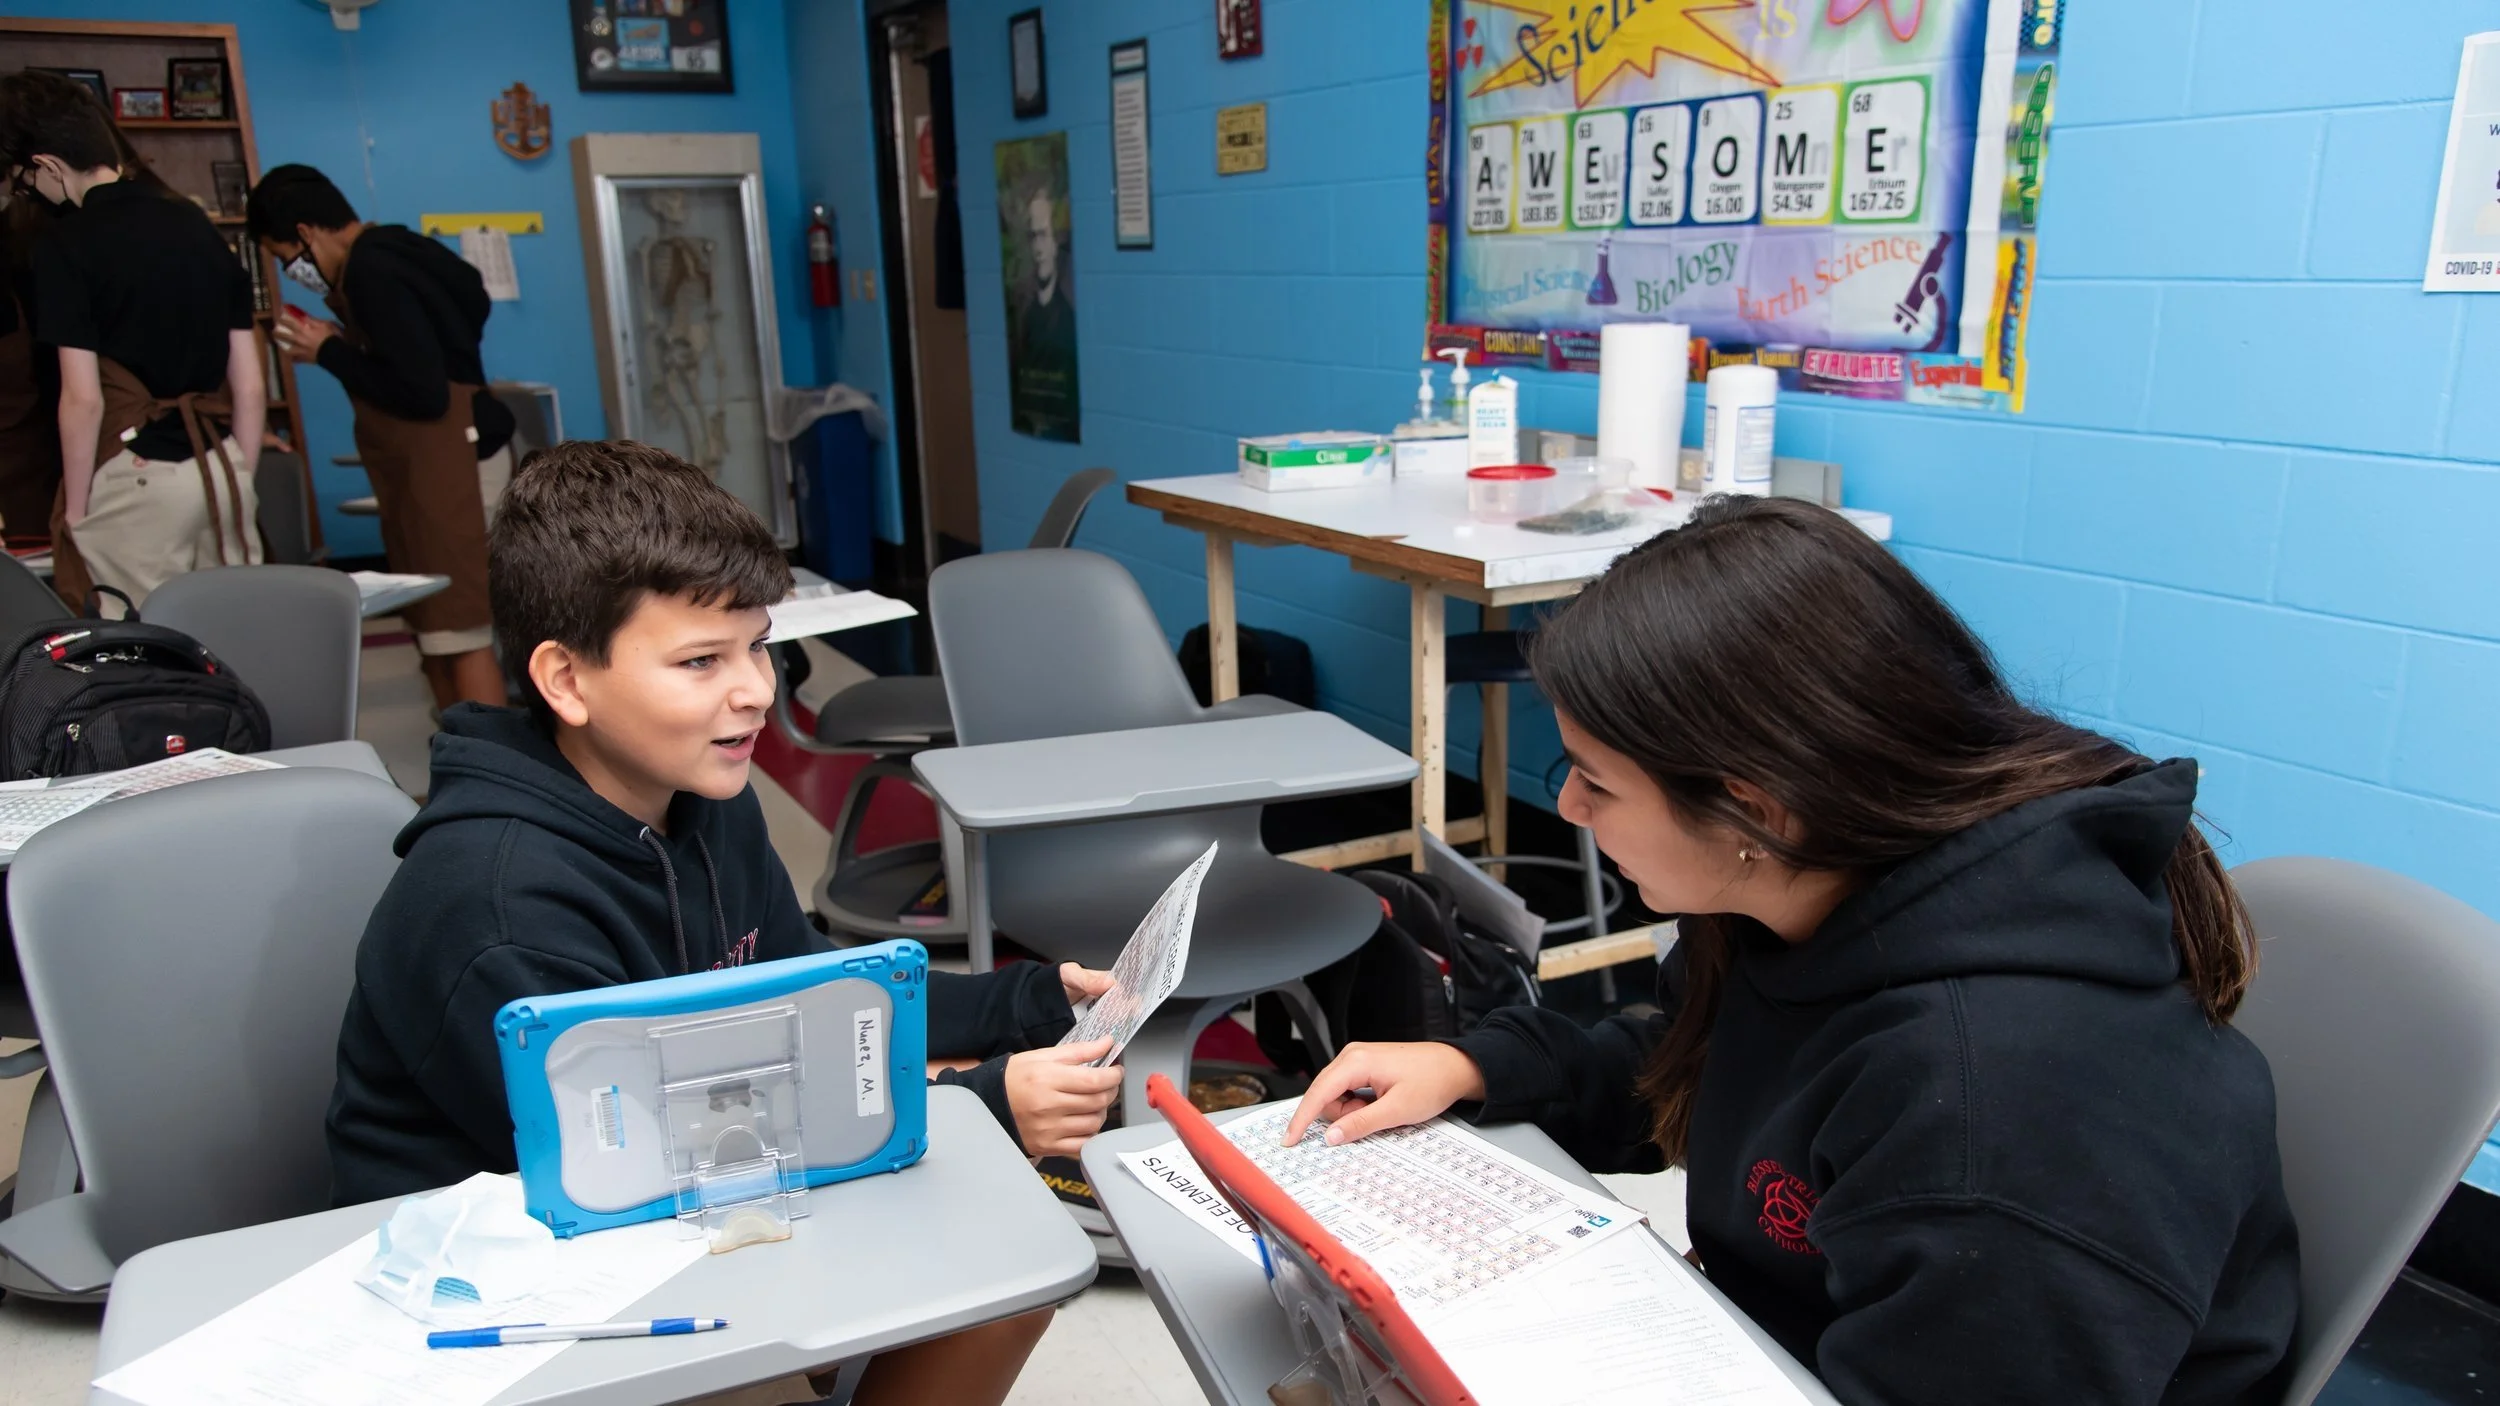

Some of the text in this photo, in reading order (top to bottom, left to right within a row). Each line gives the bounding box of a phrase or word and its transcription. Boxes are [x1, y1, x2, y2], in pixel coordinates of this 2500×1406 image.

[1516, 0, 1658, 87] Scien
[1775, 101, 1792, 121] 25
[1853, 93, 1872, 113] 68
[1638, 116, 1654, 133] 16
[1702, 109, 1710, 127] 8
[1578, 122, 1592, 139] 63
[1651, 142, 1668, 182] S
[1712, 136, 1738, 177] O
[1528, 152, 1555, 188] W
[1773, 182, 1825, 193] Manganese
[1868, 178, 1906, 189] Erbium
[1705, 197, 1743, 215] 16.00
[1772, 194, 1813, 212] 54.94
[1850, 191, 1905, 212] 167.26
[1634, 241, 1739, 314] Biology
[1735, 235, 1922, 321] Earth Science
[2445, 261, 2493, 275] COVID-19
[1803, 349, 1902, 382] EVALUATE
[857, 1019, 875, 1101] Nunez, M.
[1142, 1157, 1231, 1217] ELEMENTS
